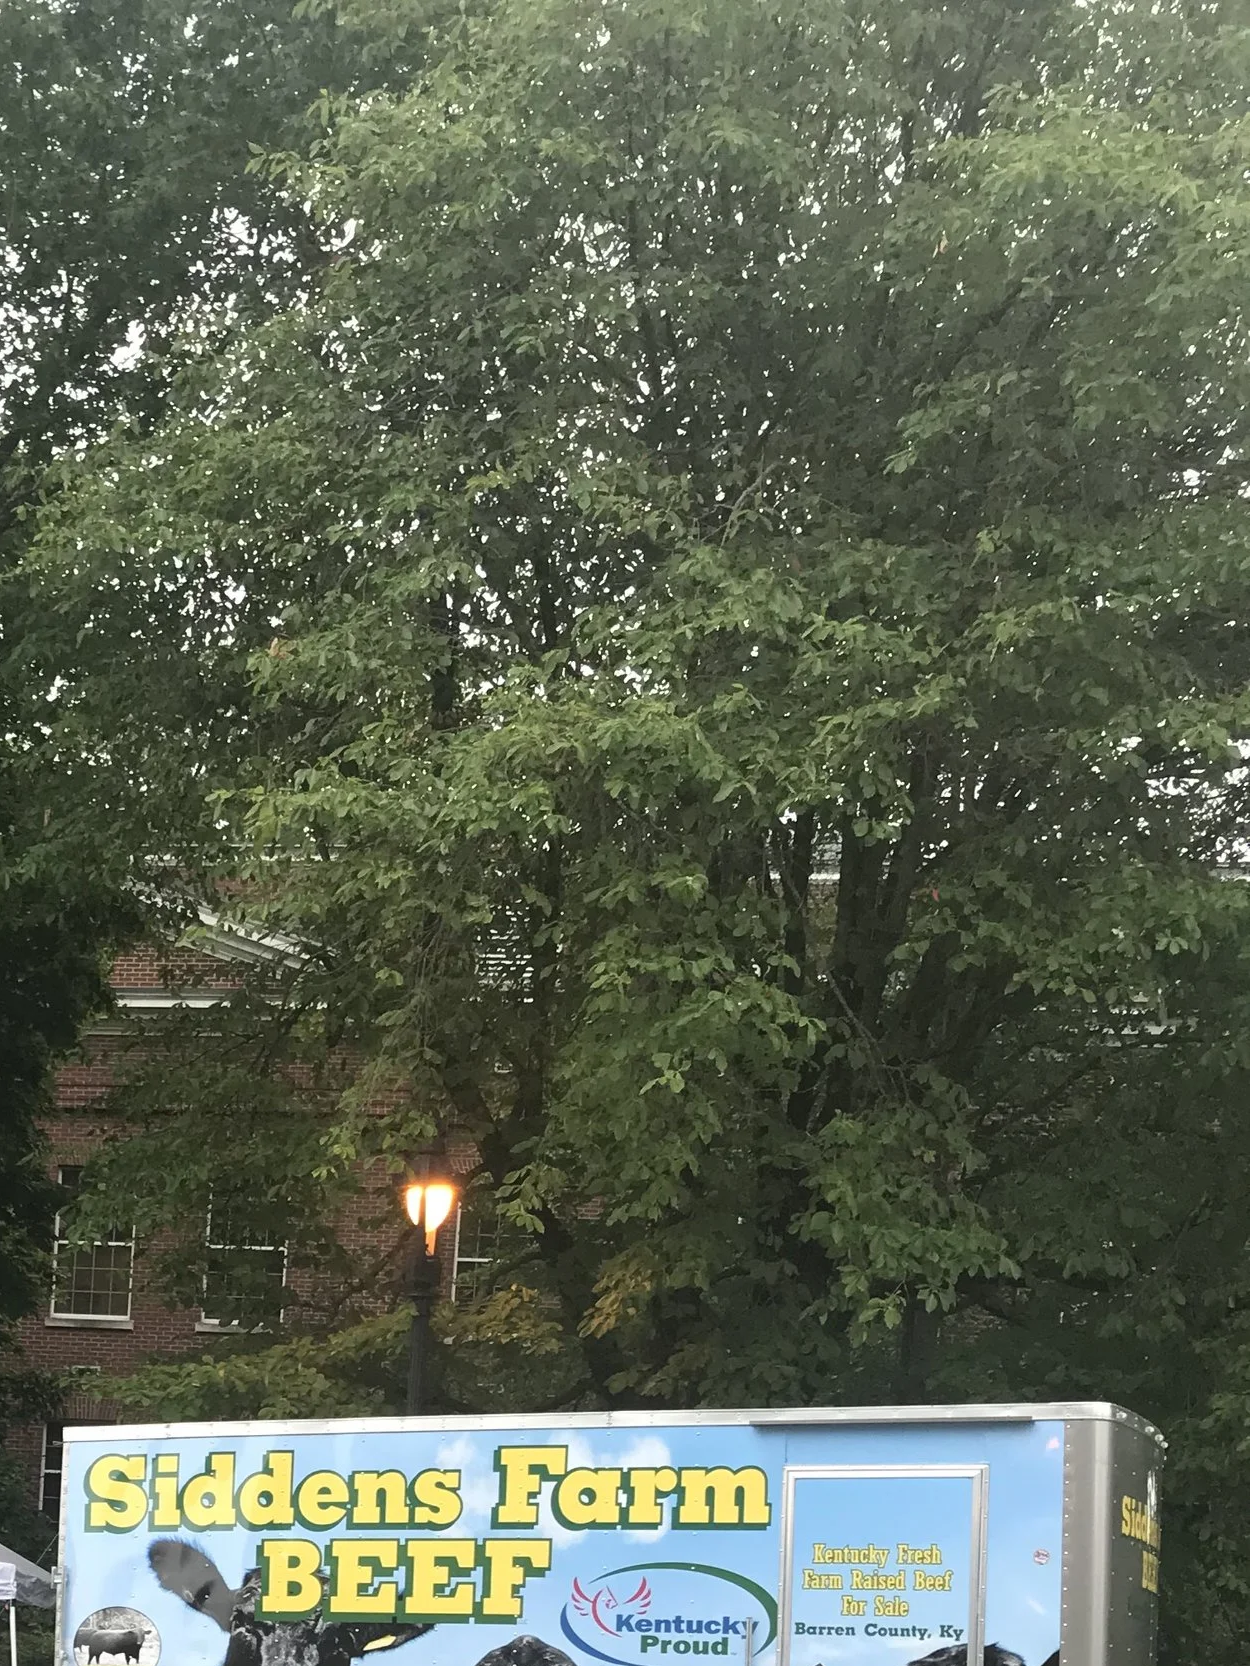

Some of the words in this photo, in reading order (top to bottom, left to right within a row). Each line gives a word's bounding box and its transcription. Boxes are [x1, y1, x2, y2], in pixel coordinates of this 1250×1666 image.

[84, 1451, 463, 1533] Siddens
[490, 1445, 772, 1531] Farm
[812, 1543, 889, 1568] Kentucky
[897, 1543, 942, 1565] Fresh
[254, 1538, 552, 1625] BEEF
[802, 1569, 843, 1590] Farm
[851, 1570, 906, 1591] Raised
[914, 1570, 954, 1591] Beef
[841, 1595, 867, 1616] For
[874, 1595, 910, 1617] Sale
[616, 1613, 760, 1639] Kentucky
[794, 1622, 856, 1637] Barren
[864, 1623, 932, 1640] County,
[940, 1624, 964, 1641] Ky
[640, 1635, 729, 1656] Proud
